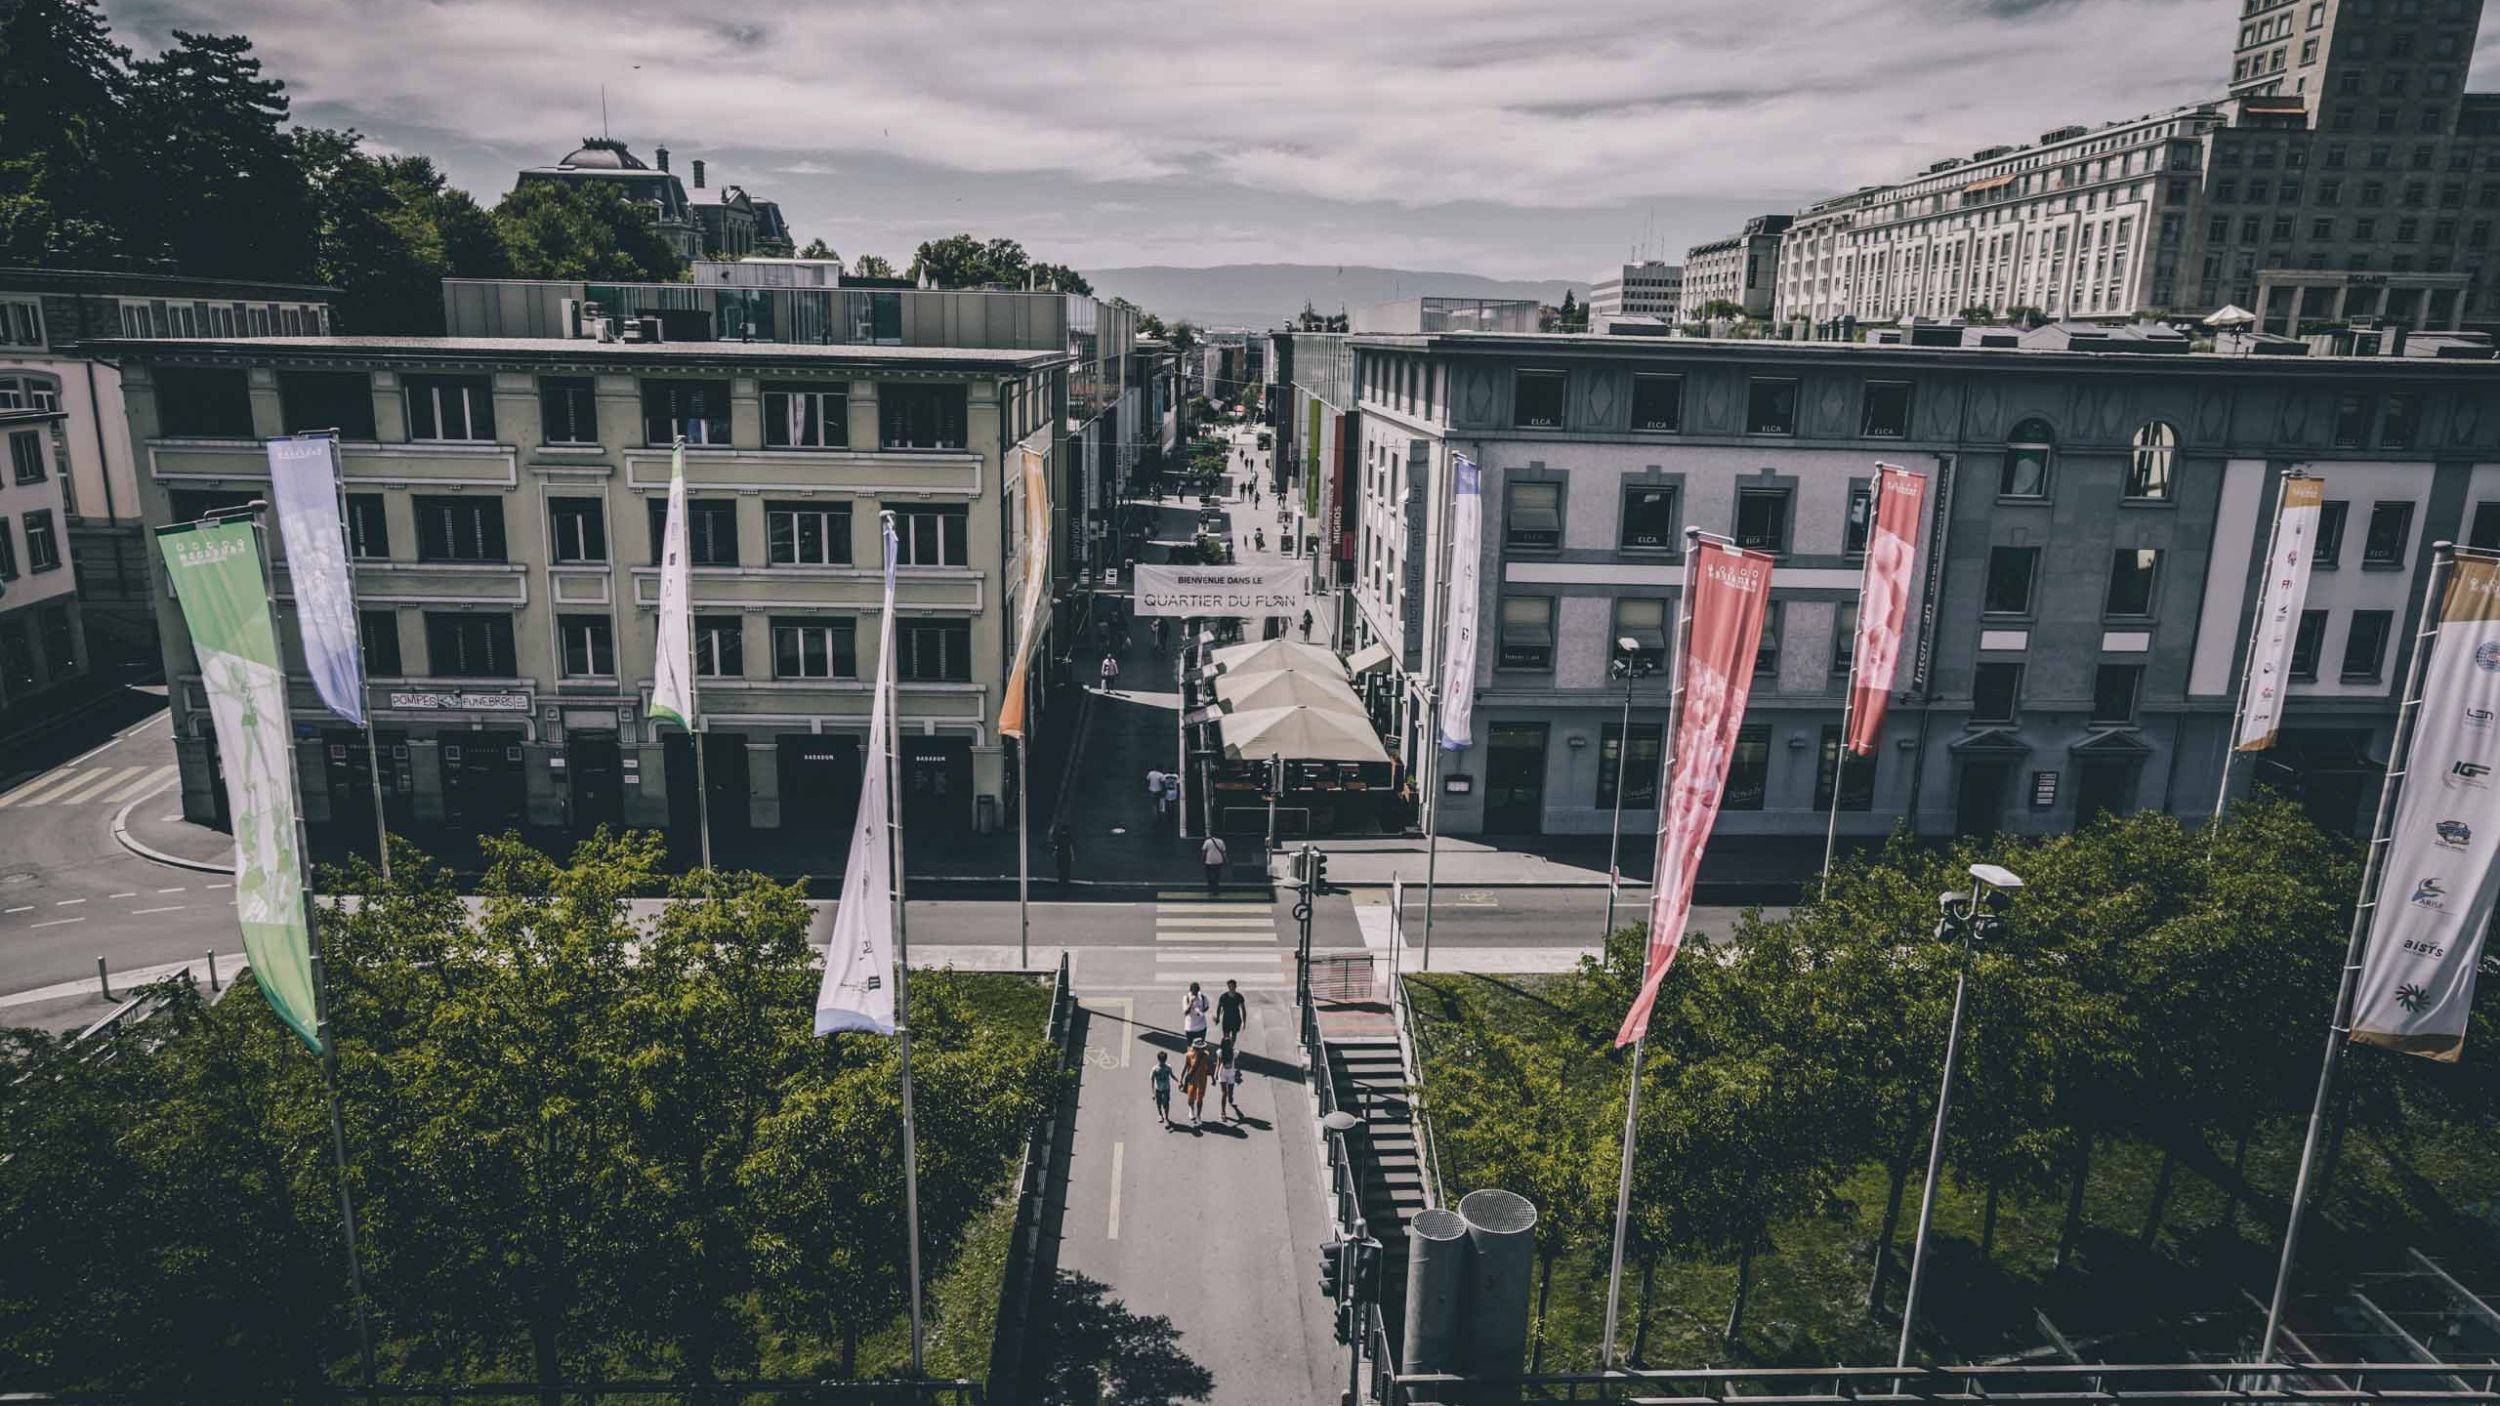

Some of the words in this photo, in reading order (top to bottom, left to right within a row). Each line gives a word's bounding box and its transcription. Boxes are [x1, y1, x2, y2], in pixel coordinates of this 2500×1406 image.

[1531, 418, 1551, 426] ELCA
[1647, 421, 1667, 429] ELCA
[1762, 425, 1781, 433] ELCA
[1411, 481, 1423, 504] bar
[1333, 505, 1342, 545] MIGROS
[1638, 536, 1657, 544] ELCA
[1178, 576, 1225, 585] BIENVENUE
[1228, 576, 1251, 585] DANS
[1253, 576, 1263, 585] LE
[1144, 594, 1223, 608] QUARTIER
[1228, 594, 1251, 608] DU
[392, 695, 437, 707] POMPES
[2452, 760, 2492, 778] IGF
